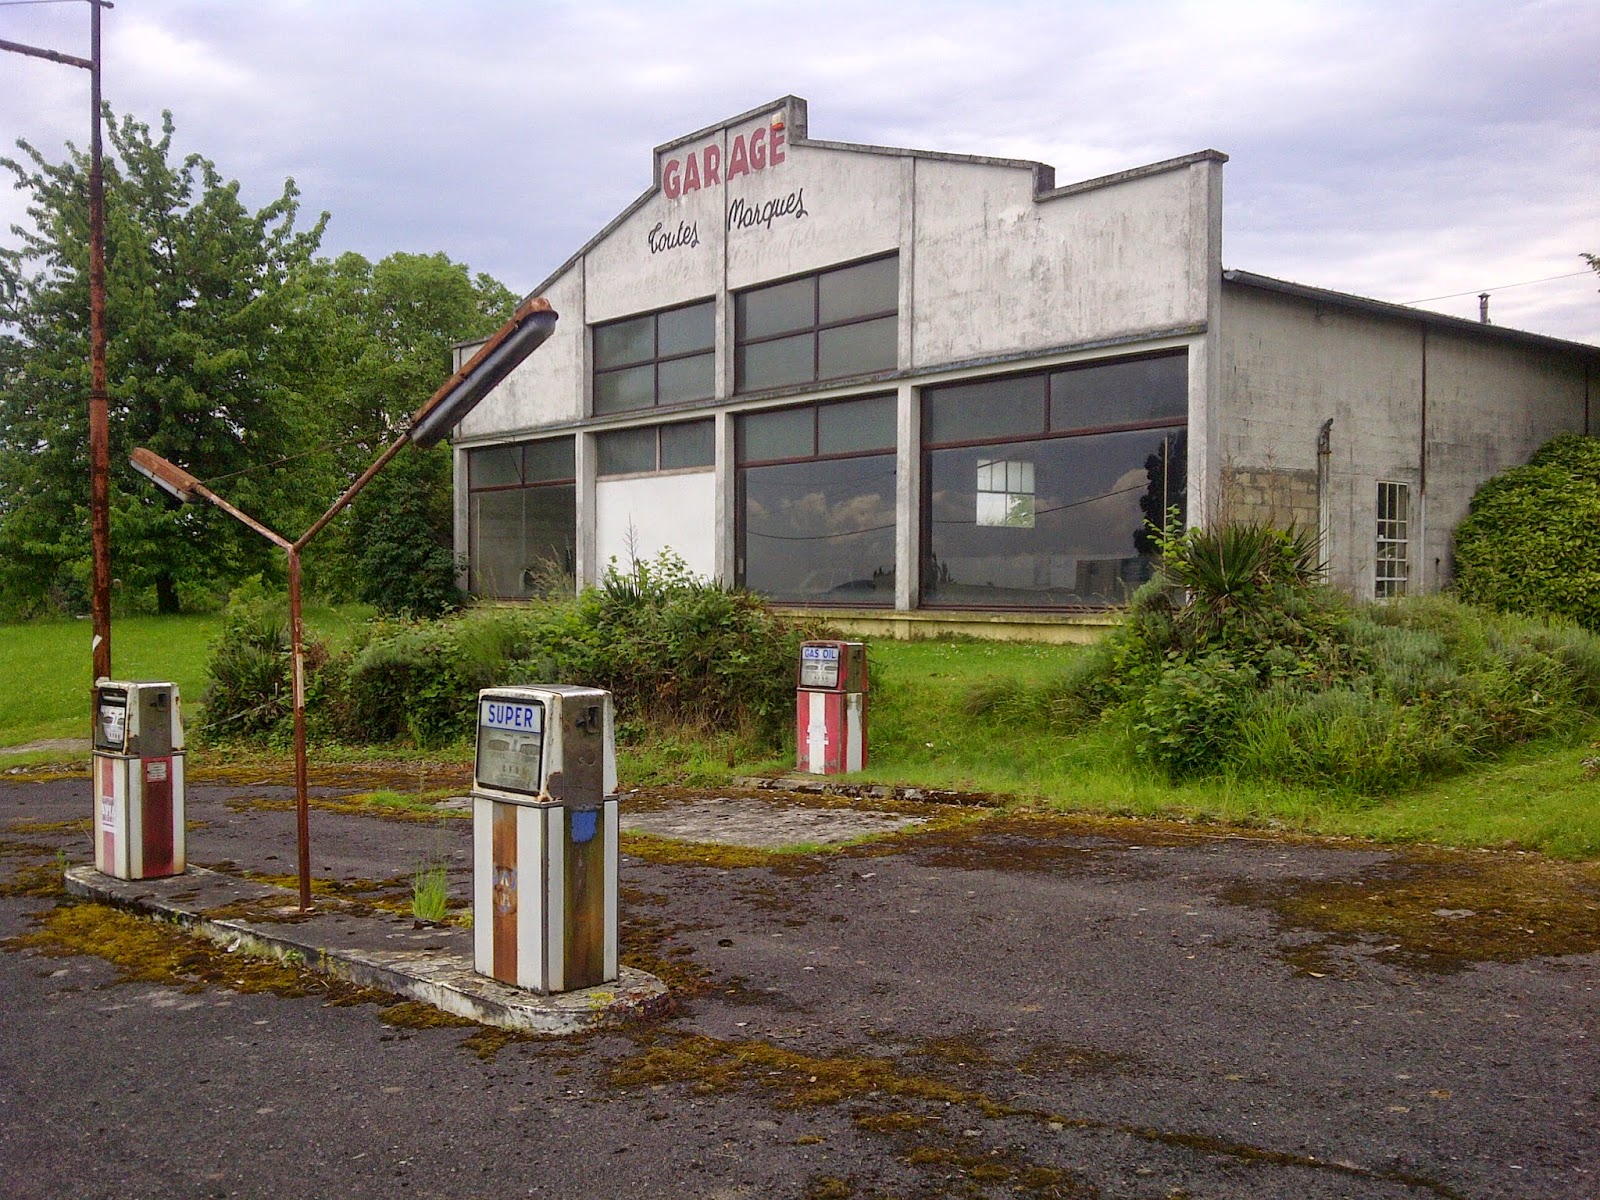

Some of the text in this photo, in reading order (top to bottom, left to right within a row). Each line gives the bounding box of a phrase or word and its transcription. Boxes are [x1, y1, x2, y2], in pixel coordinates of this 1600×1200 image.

[663, 123, 785, 200] GARAGE
[648, 188, 808, 254] Toutes Marques
[804, 648, 836, 659] GAS OIL
[488, 704, 533, 728] SUPER
